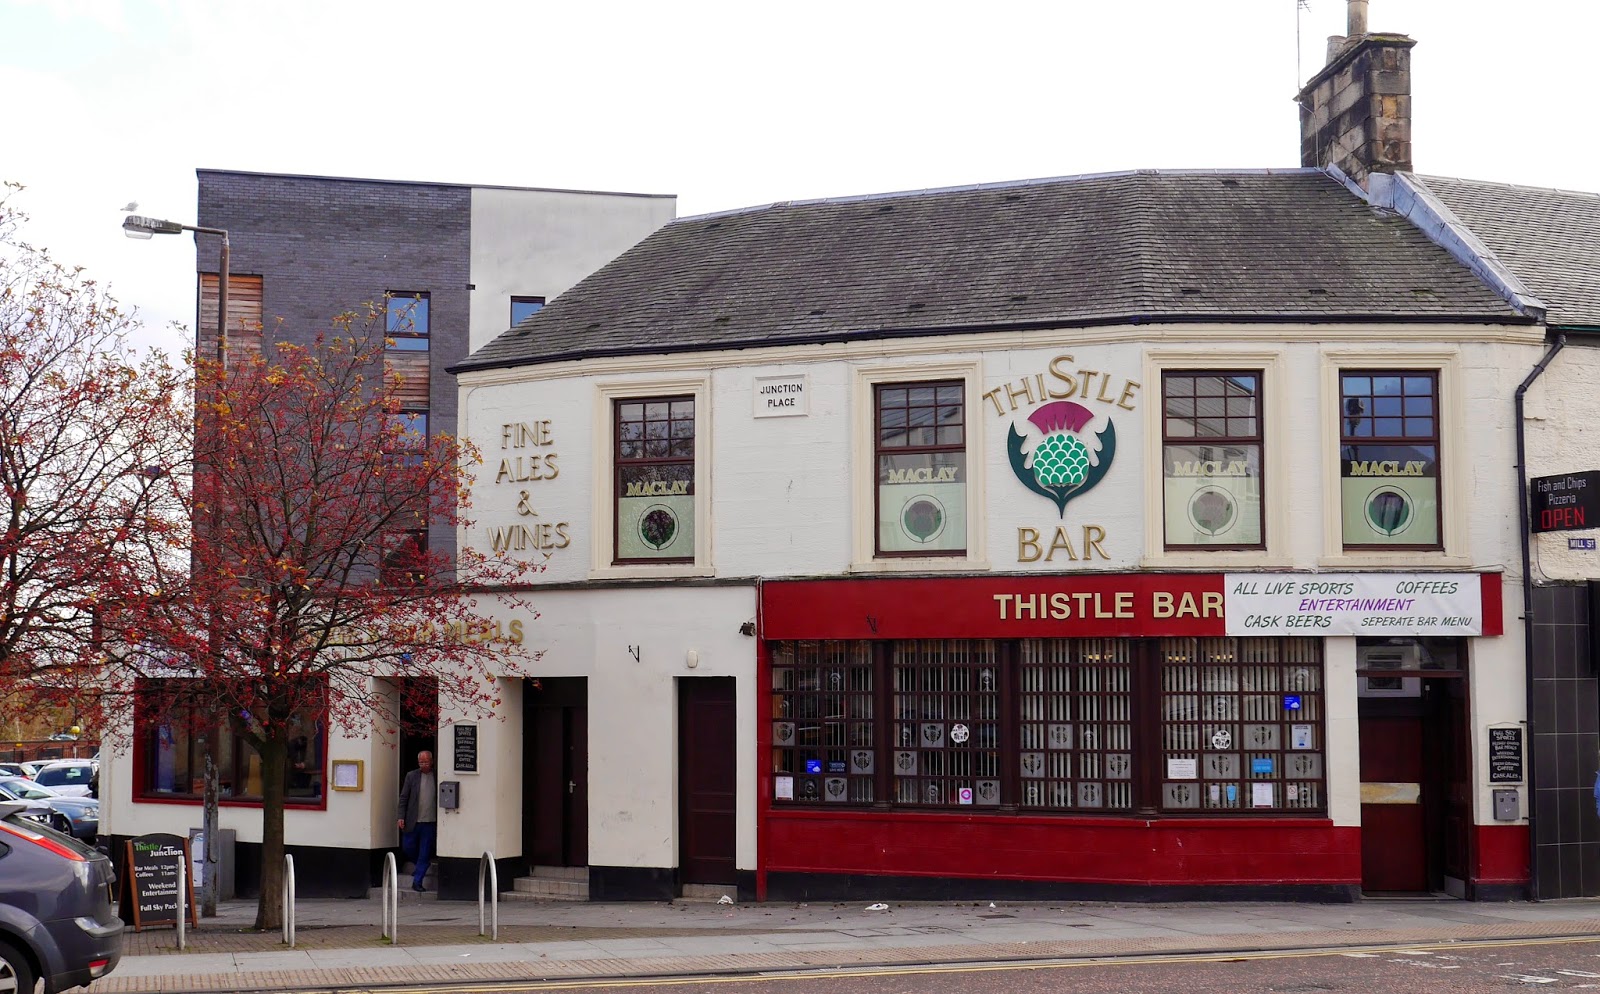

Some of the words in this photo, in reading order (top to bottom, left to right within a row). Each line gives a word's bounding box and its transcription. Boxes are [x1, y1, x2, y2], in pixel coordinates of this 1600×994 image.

[760, 383, 803, 394] JUNCTION
[983, 354, 1141, 417] THISTLE
[767, 397, 796, 408] PLACE
[501, 419, 554, 450] FINE
[495, 453, 559, 484] ALES
[887, 466, 958, 483] MACLAY
[1173, 460, 1249, 477] MACLAY
[1351, 461, 1426, 476] MACLAY
[625, 480, 689, 498] MACLAY
[1537, 480, 1552, 493] Fish
[1553, 478, 1566, 491] and
[1567, 476, 1587, 490] Chips
[517, 489, 539, 517] &
[1548, 493, 1577, 506] Pizzeria
[1541, 506, 1586, 529] OPEN
[486, 522, 572, 552] WINES
[1017, 523, 1111, 563] BAR
[1570, 539, 1585, 548] MILL
[1233, 582, 1259, 595] ALL
[1264, 582, 1296, 595] LIVE
[1299, 582, 1354, 595] SPORTS
[1395, 581, 1459, 595] COFFEES
[993, 592, 1135, 620] THISTLE
[1153, 592, 1225, 618] BAR
[1298, 598, 1416, 612] ENTERTAINMENT
[1244, 615, 1282, 628] CASK
[1285, 615, 1332, 628] BEERS
[1361, 616, 1414, 627] SEPERATE
[1416, 616, 1438, 627] BAR
[1441, 616, 1473, 627] MENU
[148, 881, 176, 889] Weekend
[140, 904, 152, 912] Full
[153, 903, 163, 911] Sky
